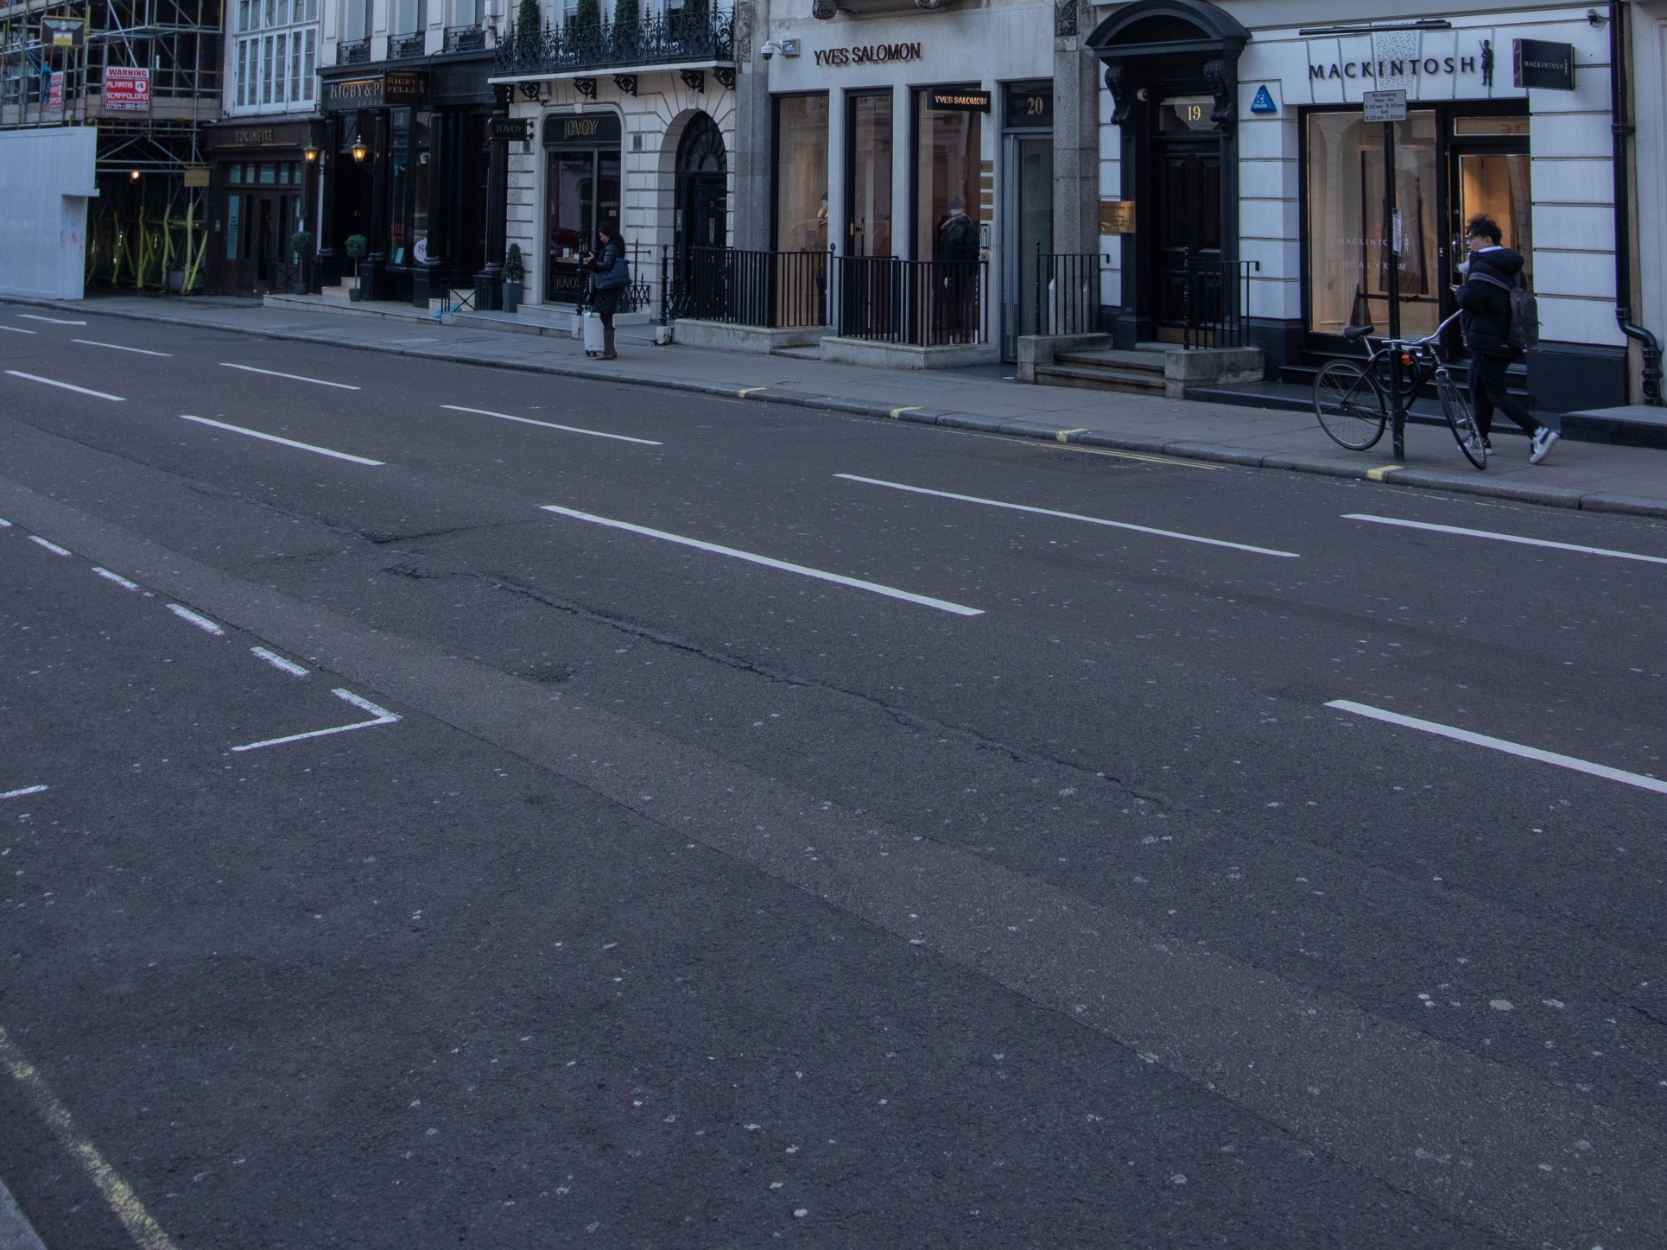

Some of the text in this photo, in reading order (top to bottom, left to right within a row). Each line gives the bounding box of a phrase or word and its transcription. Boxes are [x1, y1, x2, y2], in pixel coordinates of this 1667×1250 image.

[814, 42, 922, 66] YVES SALOMON
[1309, 57, 1475, 80] MACKINTOSH
[1523, 60, 1564, 70] MACKINTOSH
[109, 69, 147, 77] WARNING
[387, 76, 416, 85] RIGBY
[106, 92, 149, 100] SCAFFOLDING
[934, 95, 987, 105] YVES SALOMON
[1026, 97, 1044, 115] 20
[1187, 105, 1201, 121] 19
[495, 124, 522, 134] JOVOY
[564, 119, 599, 139] JOVOY
[1338, 237, 1388, 247] MACKINTO
